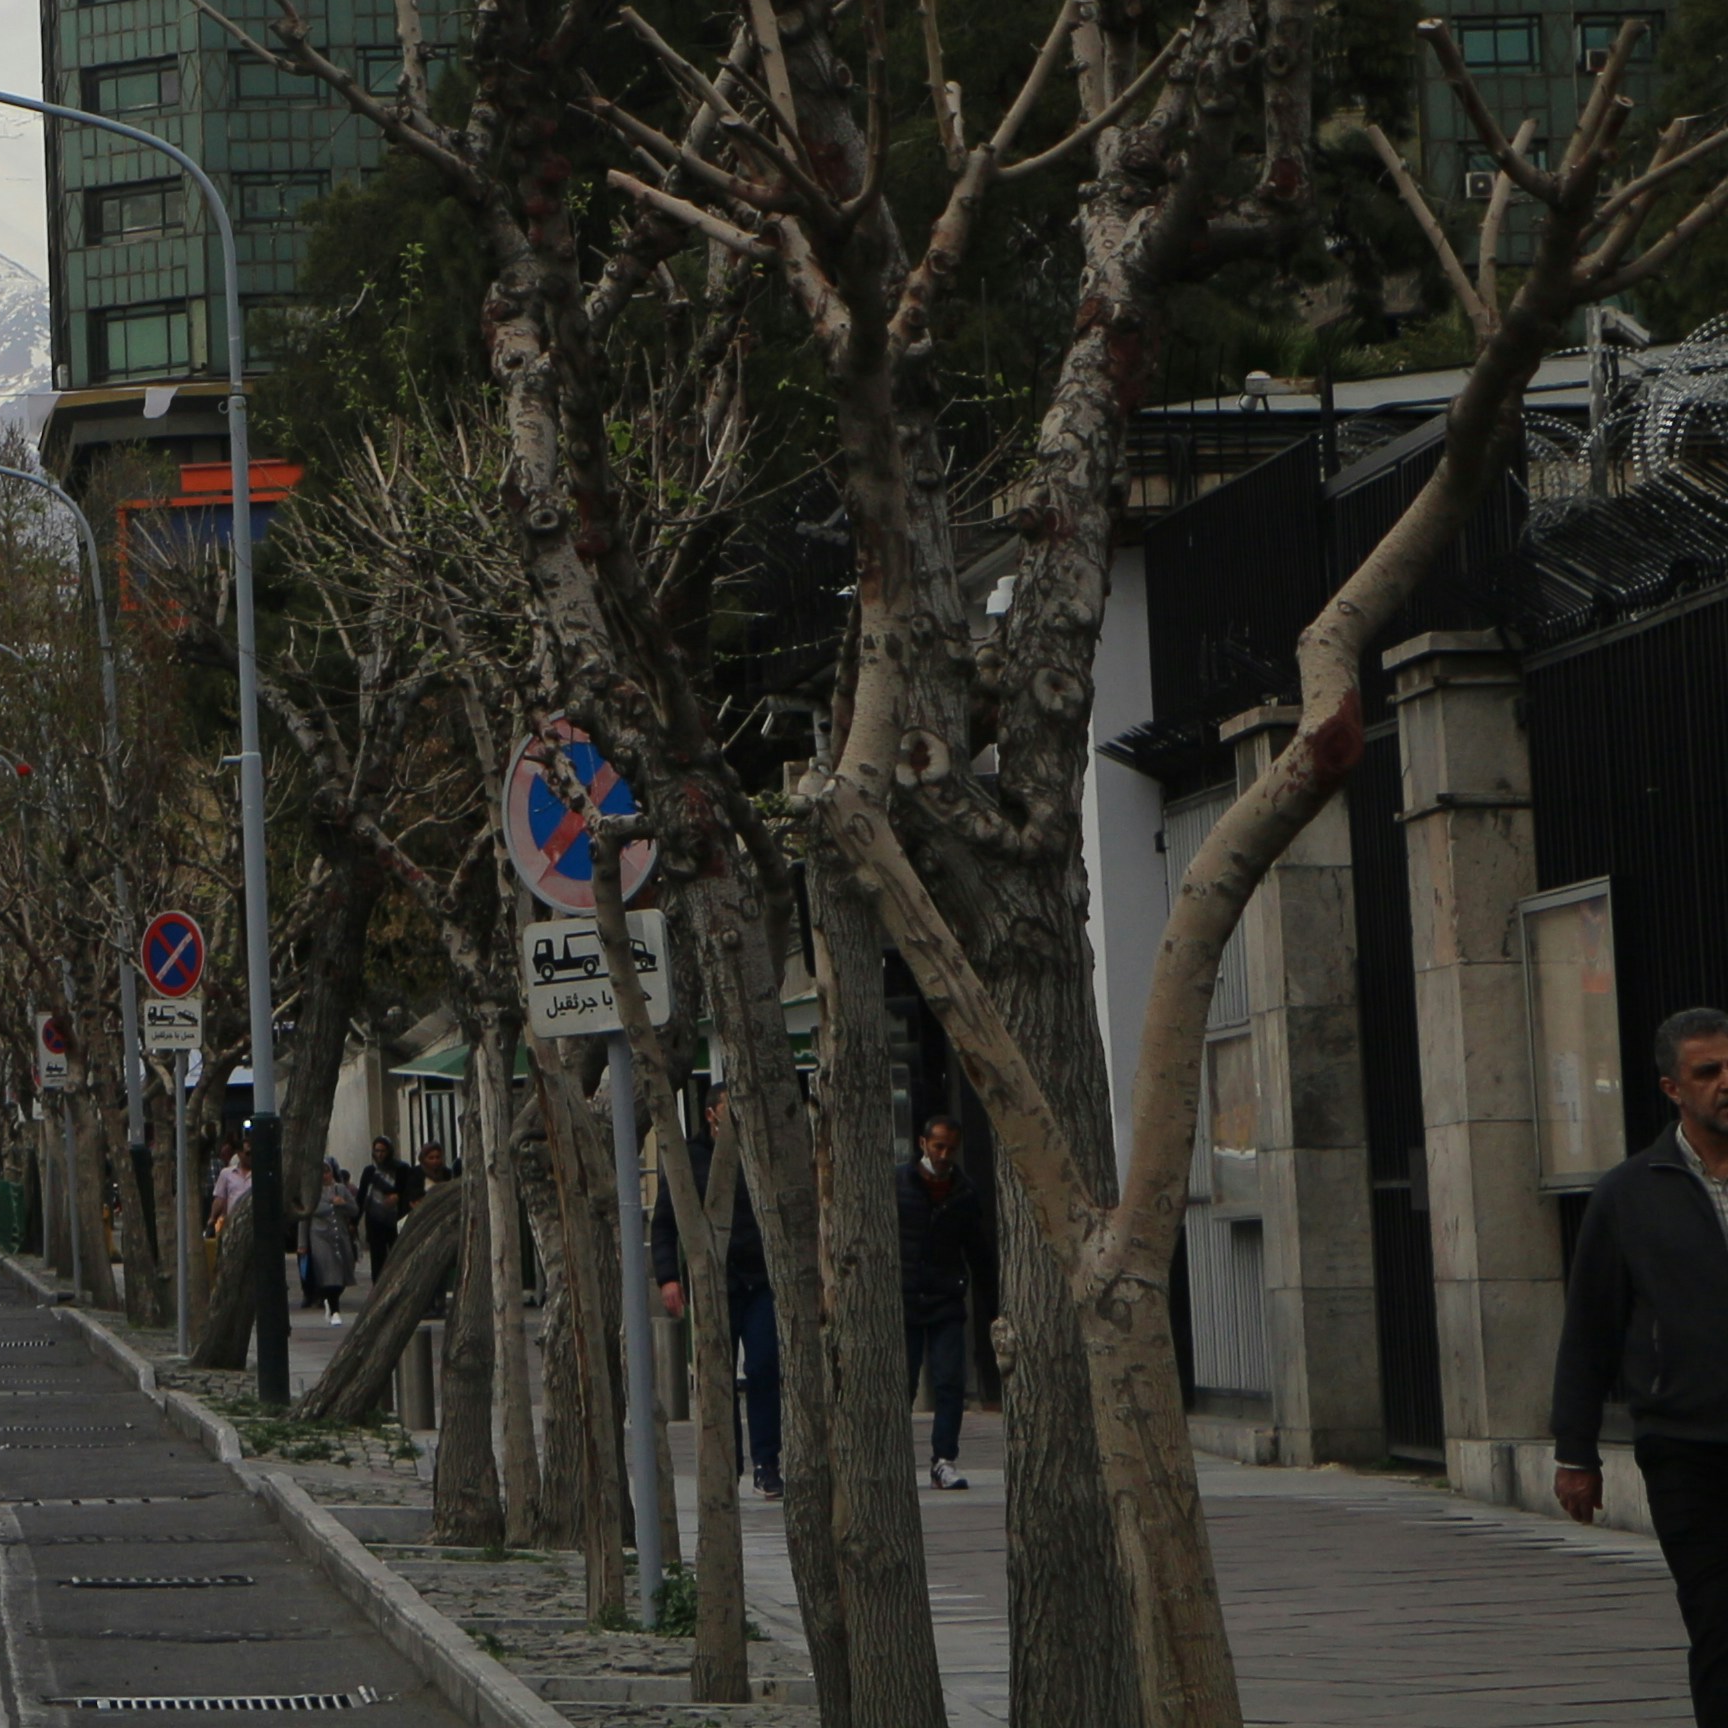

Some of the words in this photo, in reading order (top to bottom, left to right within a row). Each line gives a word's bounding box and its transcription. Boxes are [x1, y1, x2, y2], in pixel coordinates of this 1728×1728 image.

[545, 992, 599, 1019] جرثقیل
[601, 990, 614, 1010] با
[151, 1030, 173, 1041] جرثقیل
